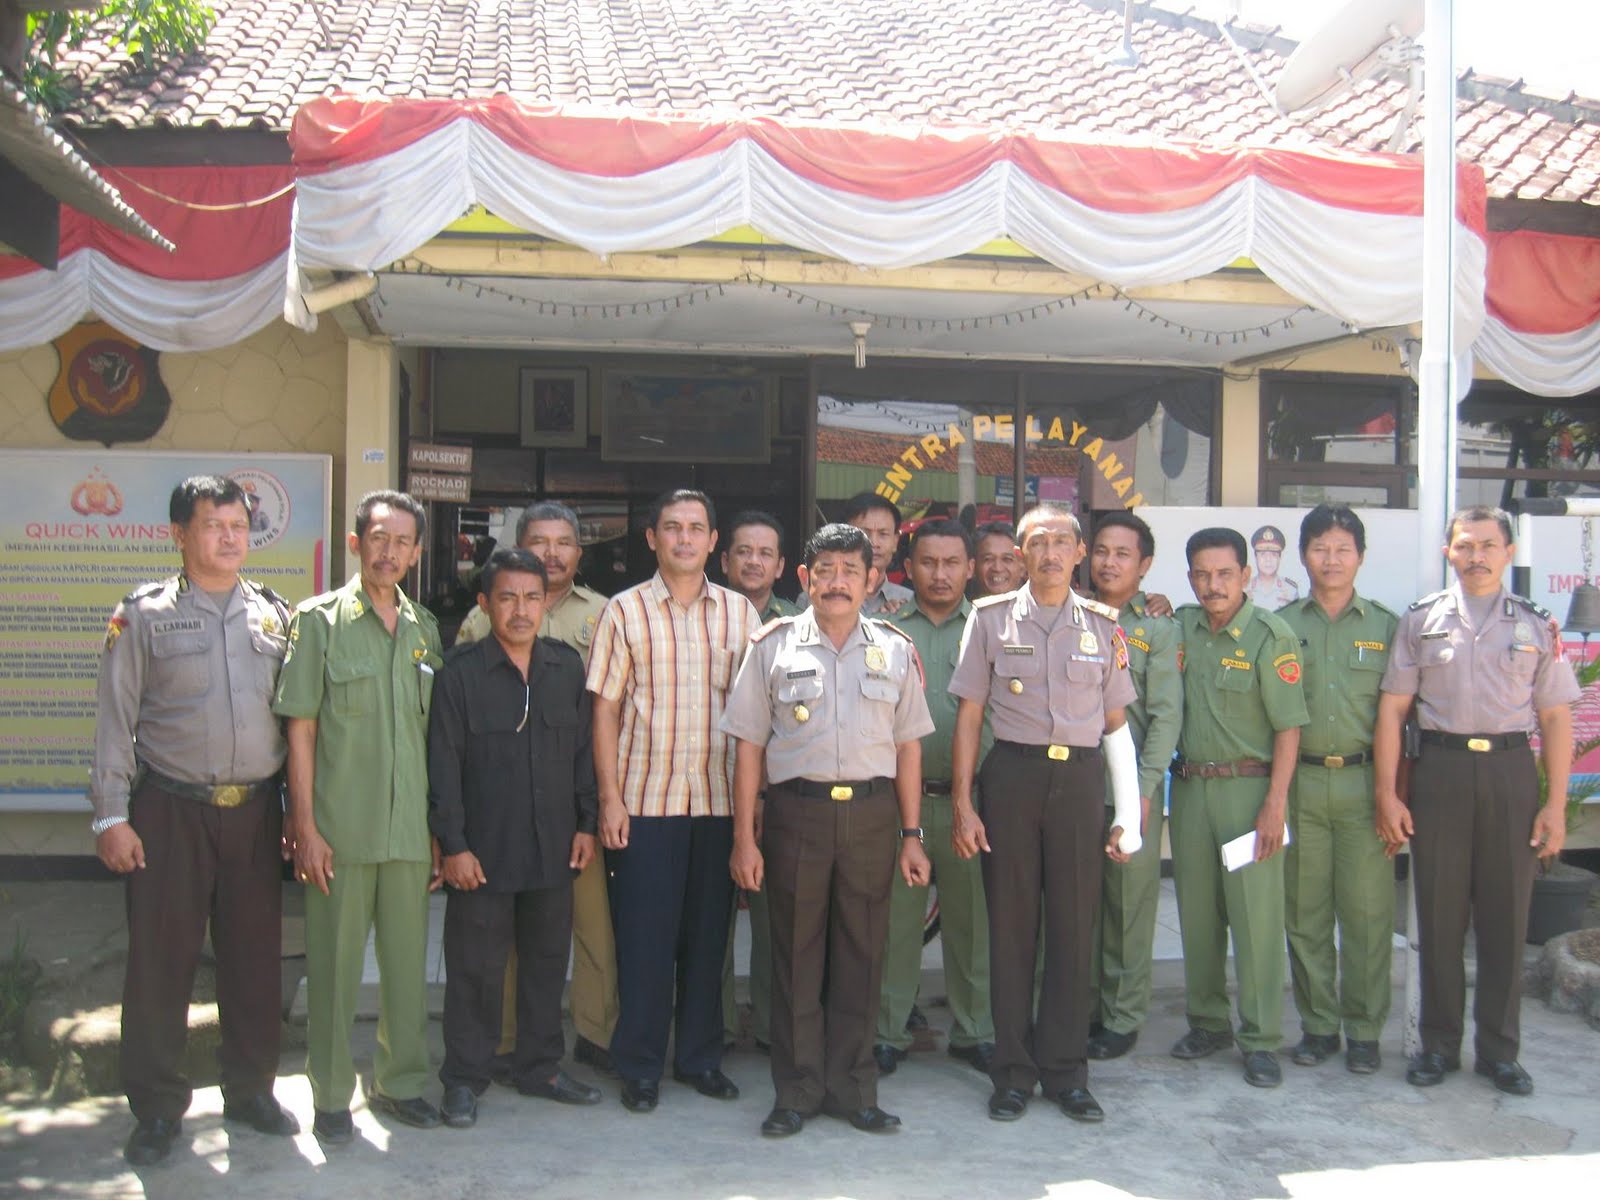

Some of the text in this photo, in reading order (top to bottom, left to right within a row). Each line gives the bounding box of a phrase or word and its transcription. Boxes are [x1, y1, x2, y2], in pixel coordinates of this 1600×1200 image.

[875, 422, 966, 505] ENTRA
[26, 522, 169, 540] QUICK WINS
[253, 527, 279, 547] WINS
[142, 544, 179, 553] SEGER
[240, 566, 284, 575] ANSFORMASI
